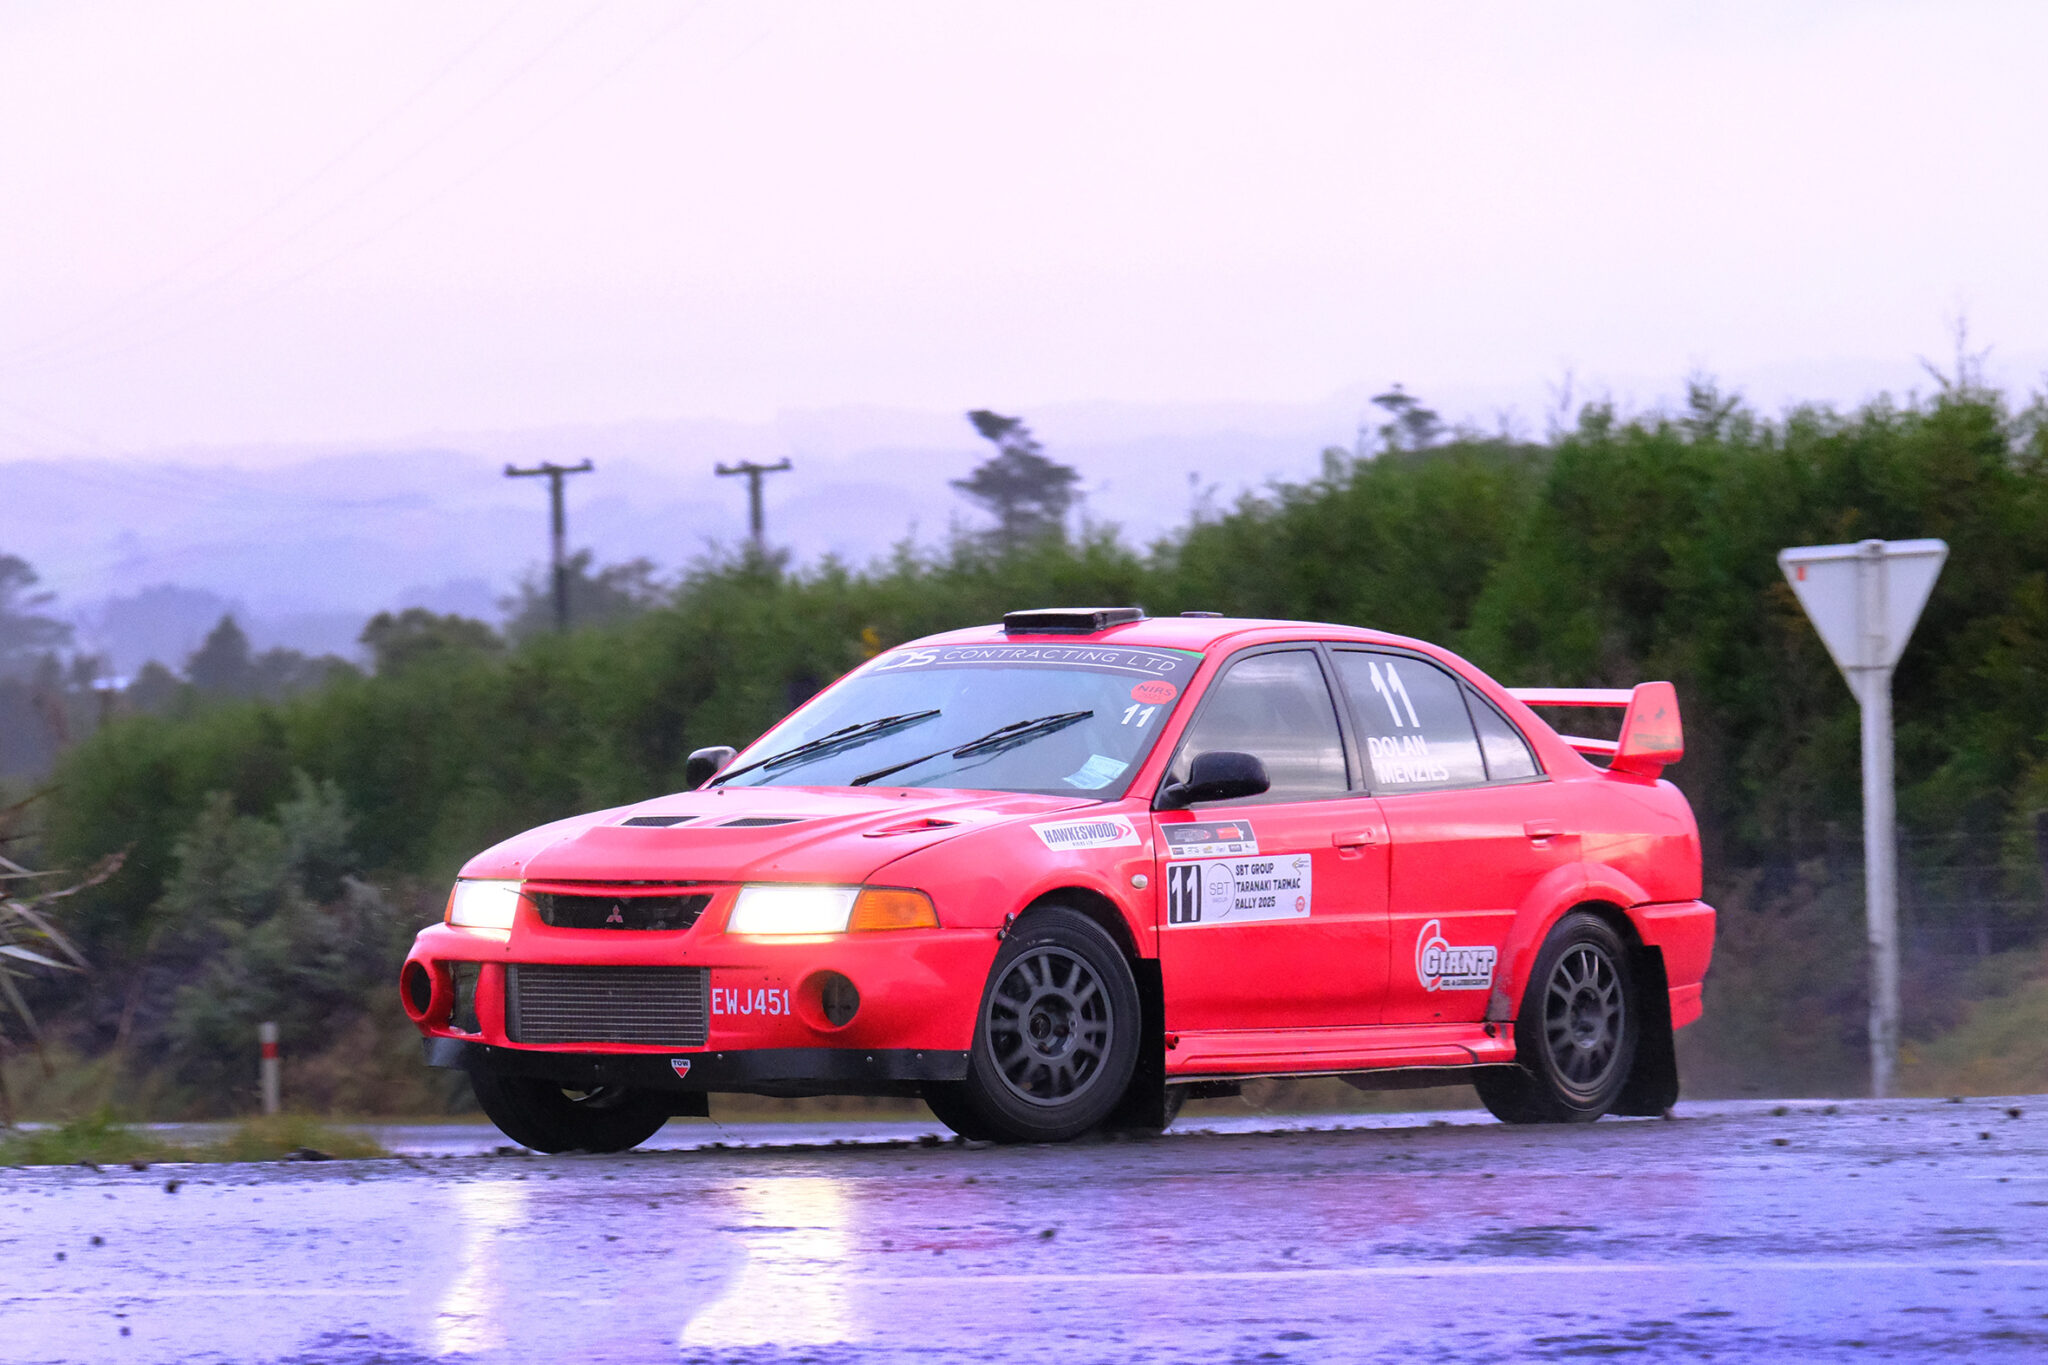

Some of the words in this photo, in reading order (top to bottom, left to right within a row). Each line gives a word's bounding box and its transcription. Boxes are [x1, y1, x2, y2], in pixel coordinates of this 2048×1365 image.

[944, 649, 1119, 664] CONTRACTING
[1127, 655, 1176, 672] LTD
[1138, 684, 1172, 697] NIRS
[1368, 662, 1421, 728] 11
[1121, 703, 1156, 728] 11
[1367, 735, 1429, 758] DOLAN
[1043, 822, 1118, 844] HAWKESWOOD
[1235, 864, 1249, 876] SBT
[1250, 862, 1275, 875] GROUP
[1171, 866, 1198, 922] 11
[1209, 882, 1231, 896] SBT
[1235, 880, 1272, 893] TARANAKI
[1273, 878, 1301, 890] TARMAC
[1235, 898, 1257, 910] RALLY
[1258, 896, 1276, 908] 2025
[1424, 948, 1493, 977] GIANT
[712, 988, 791, 1015] EWJ451
